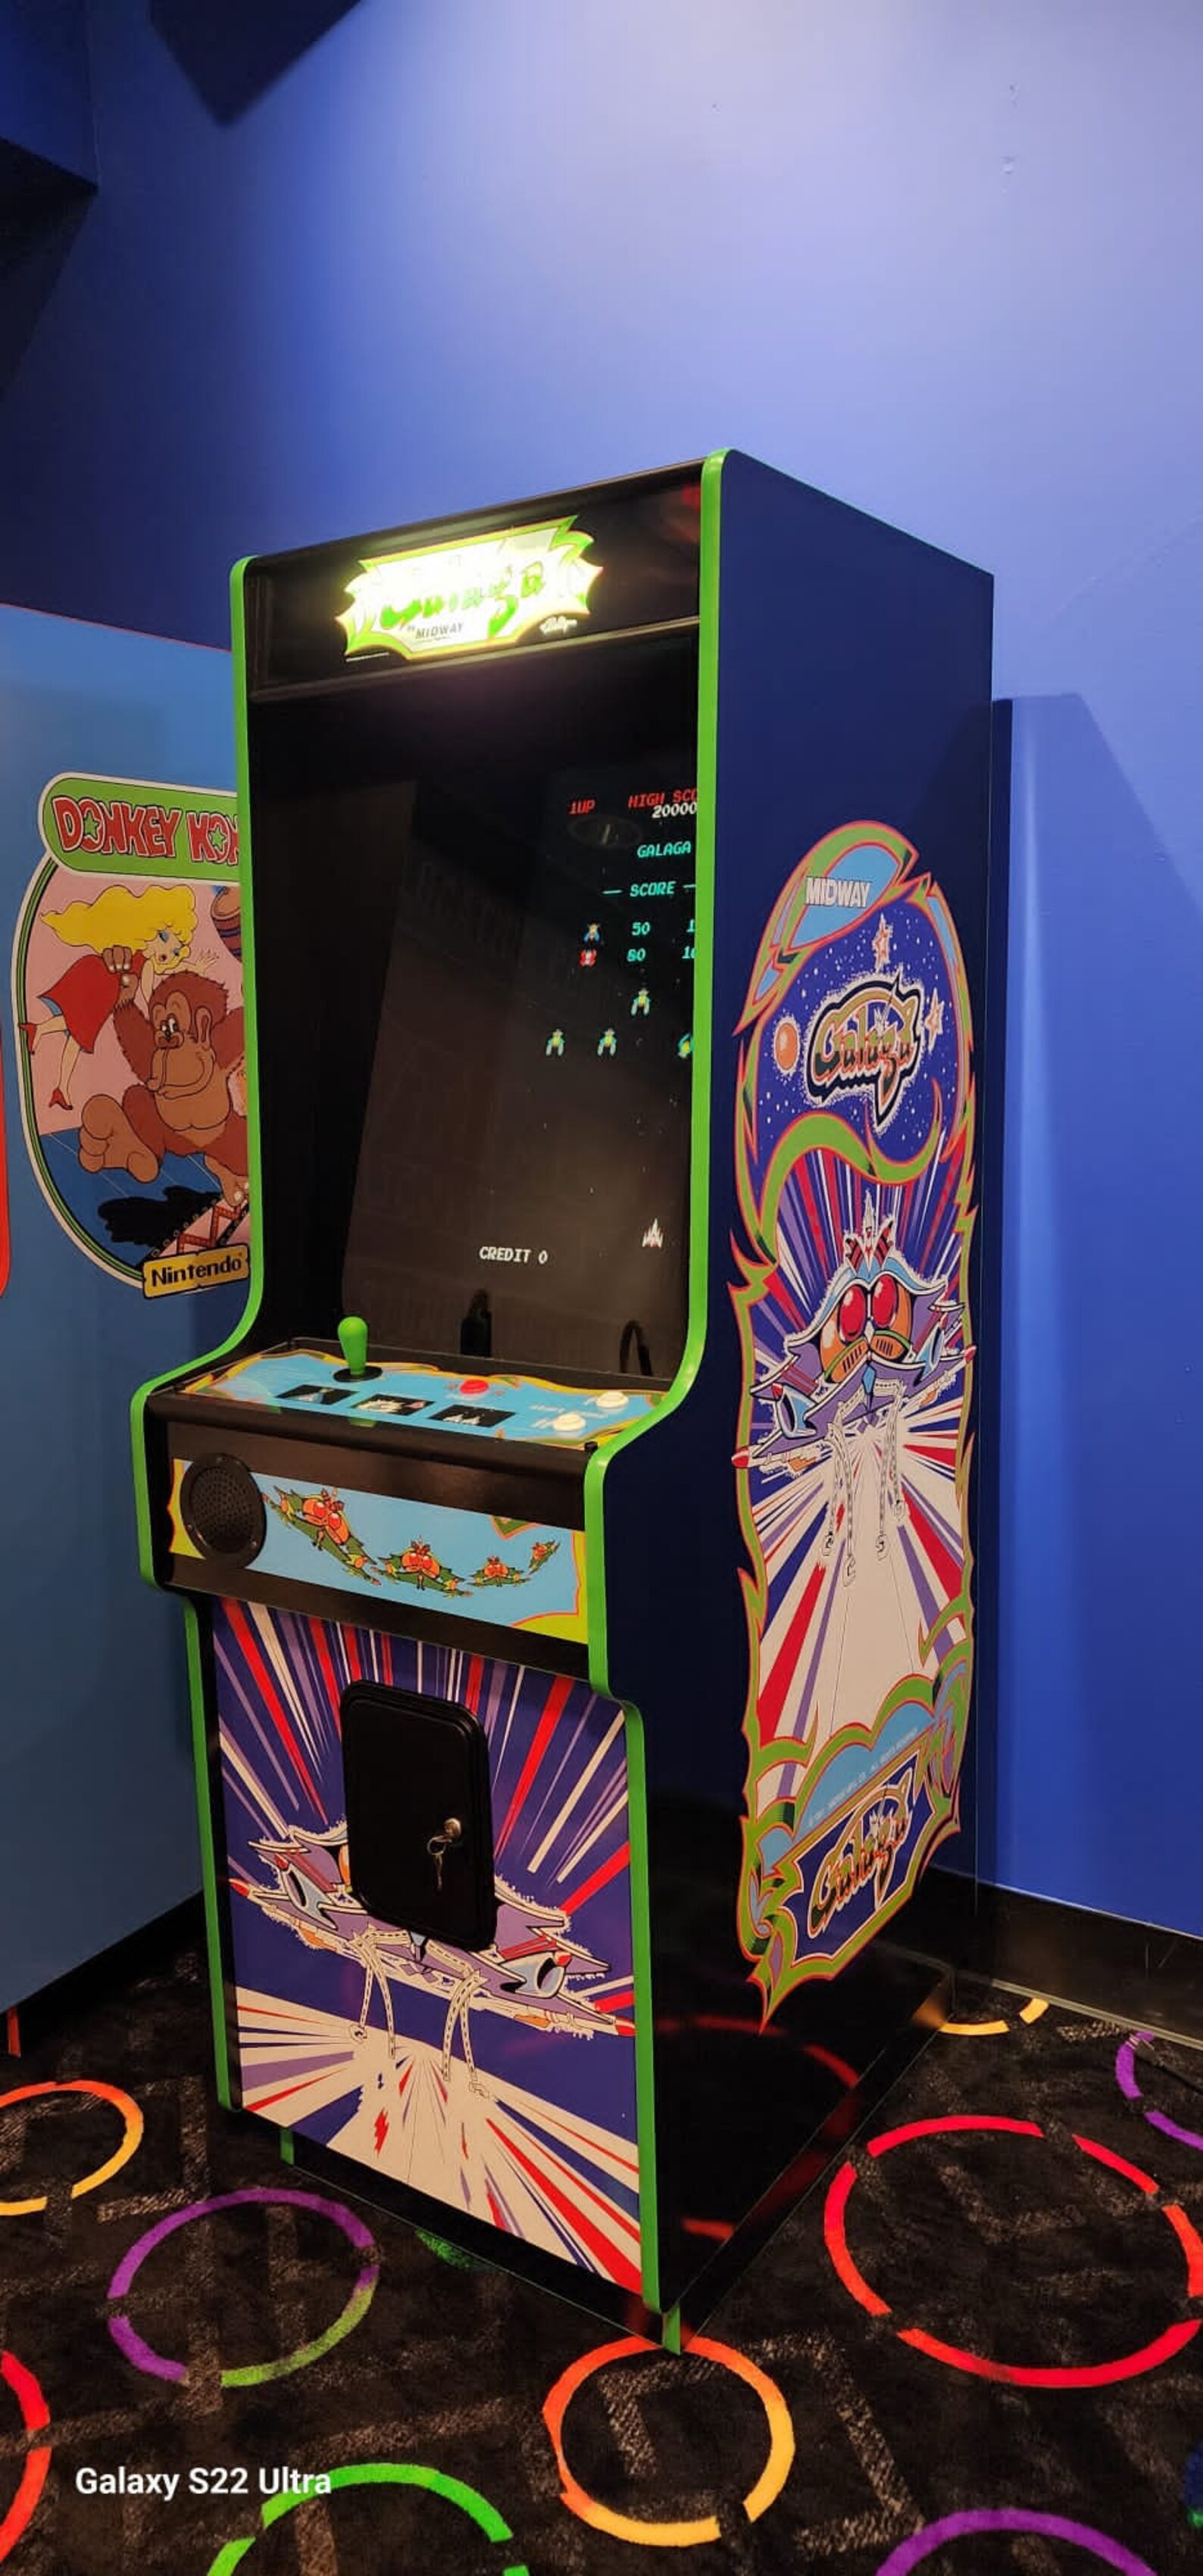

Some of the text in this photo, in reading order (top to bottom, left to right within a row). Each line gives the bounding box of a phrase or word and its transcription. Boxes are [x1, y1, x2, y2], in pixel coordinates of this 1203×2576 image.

[415, 622, 464, 639] MIDWAY
[570, 799, 595, 814] 1UP
[628, 793, 665, 808] HIGH
[651, 802, 697, 819] 20000
[52, 796, 182, 858] DONKEY
[637, 840, 691, 858] GALAGA
[630, 881, 676, 898] SCORE
[805, 876, 871, 908] MIDWAY
[631, 921, 651, 936] 50
[626, 948, 646, 962] 80
[810, 983, 920, 1118] Galaga
[479, 1246, 548, 1265] CREDIT 0
[151, 1255, 242, 1287] Nintendo
